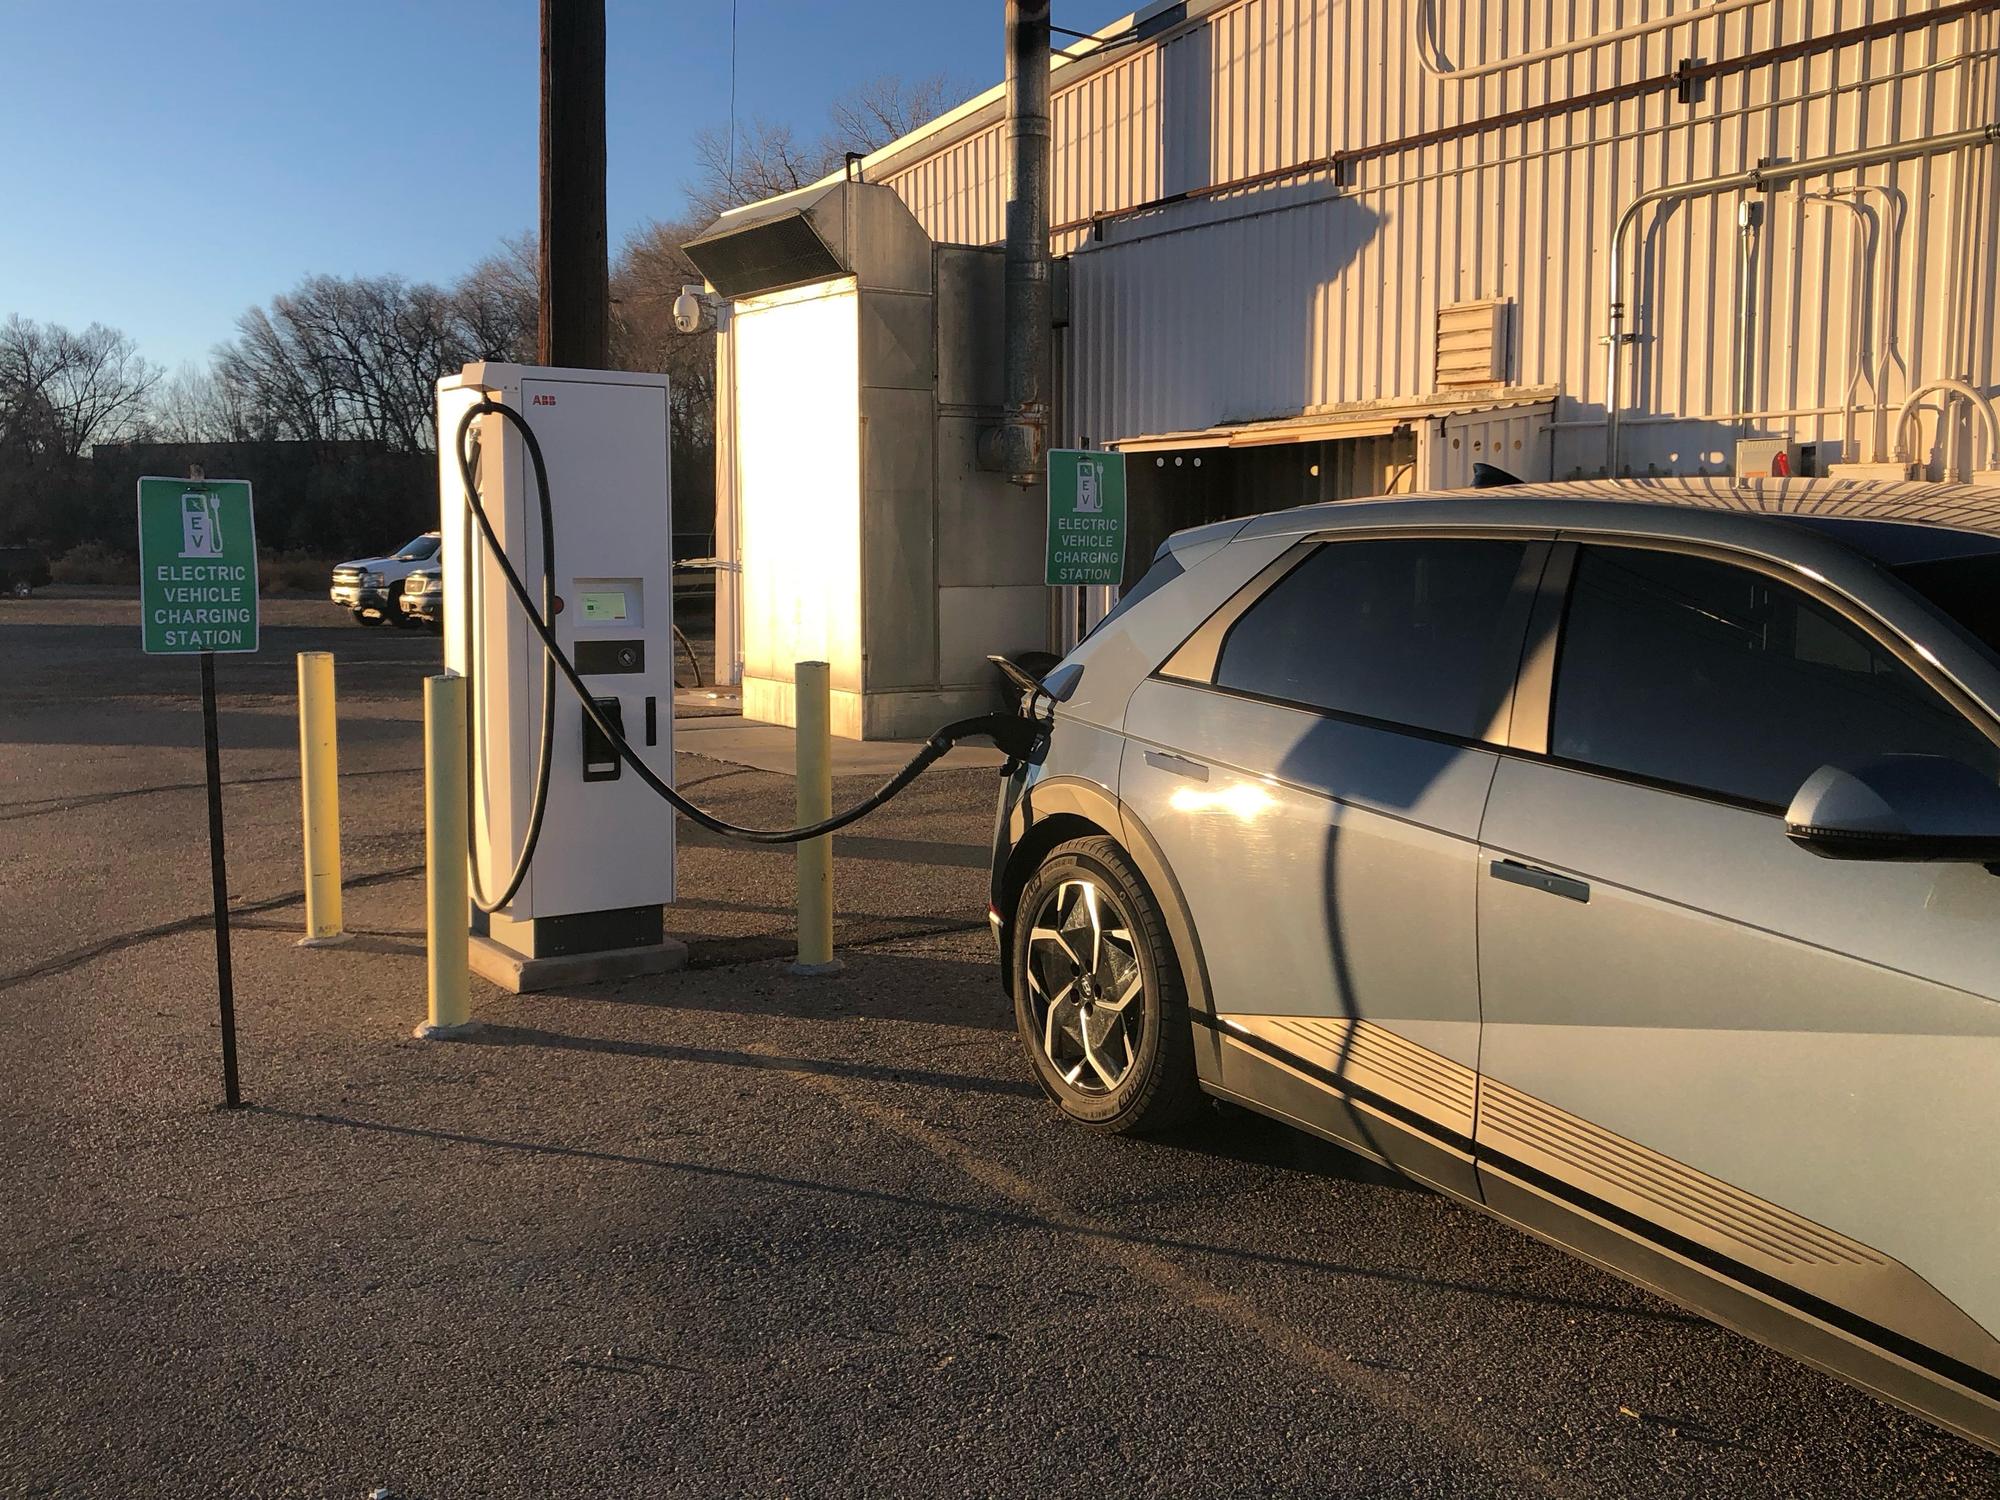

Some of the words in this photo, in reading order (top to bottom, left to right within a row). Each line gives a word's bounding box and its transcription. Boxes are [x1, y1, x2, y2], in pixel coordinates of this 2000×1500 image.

[532, 395, 556, 406] ABB
[1058, 518, 1118, 530] ELECTRIC
[1062, 535, 1113, 547] VEHICLE
[1054, 552, 1119, 564] CHARGING
[157, 566, 246, 581] ELECTRIC
[1059, 568, 1111, 580] STATION
[164, 588, 241, 602] VEHICLE
[155, 608, 250, 624] CHARGING
[165, 630, 241, 646] STATION
